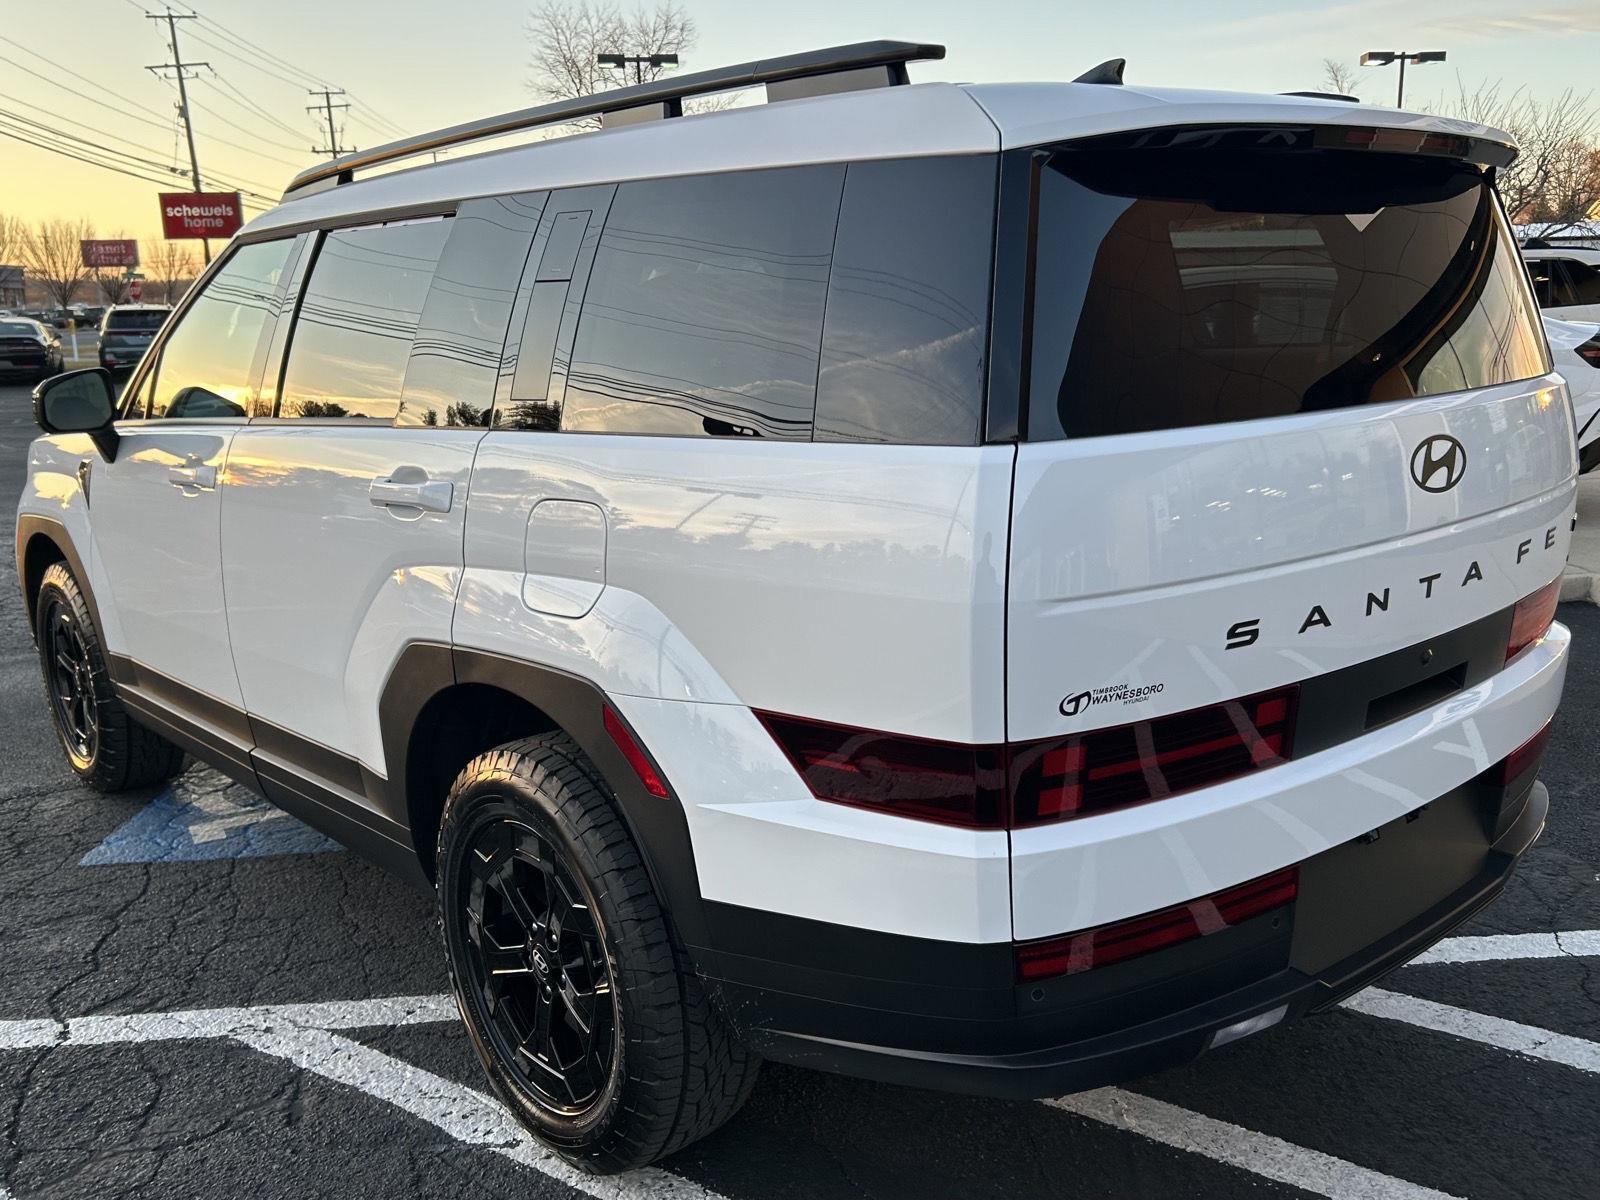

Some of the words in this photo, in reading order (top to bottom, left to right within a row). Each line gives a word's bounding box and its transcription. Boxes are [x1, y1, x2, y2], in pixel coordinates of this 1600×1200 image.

[166, 204, 233, 217] schewels
[184, 217, 224, 228] home
[1225, 561, 1483, 650] SANTA
[1516, 526, 1557, 564] FE
[1092, 684, 1128, 696] TIMBROOK
[1092, 683, 1164, 705] WAYNESBORO
[1123, 696, 1150, 706] HYUNDAI
